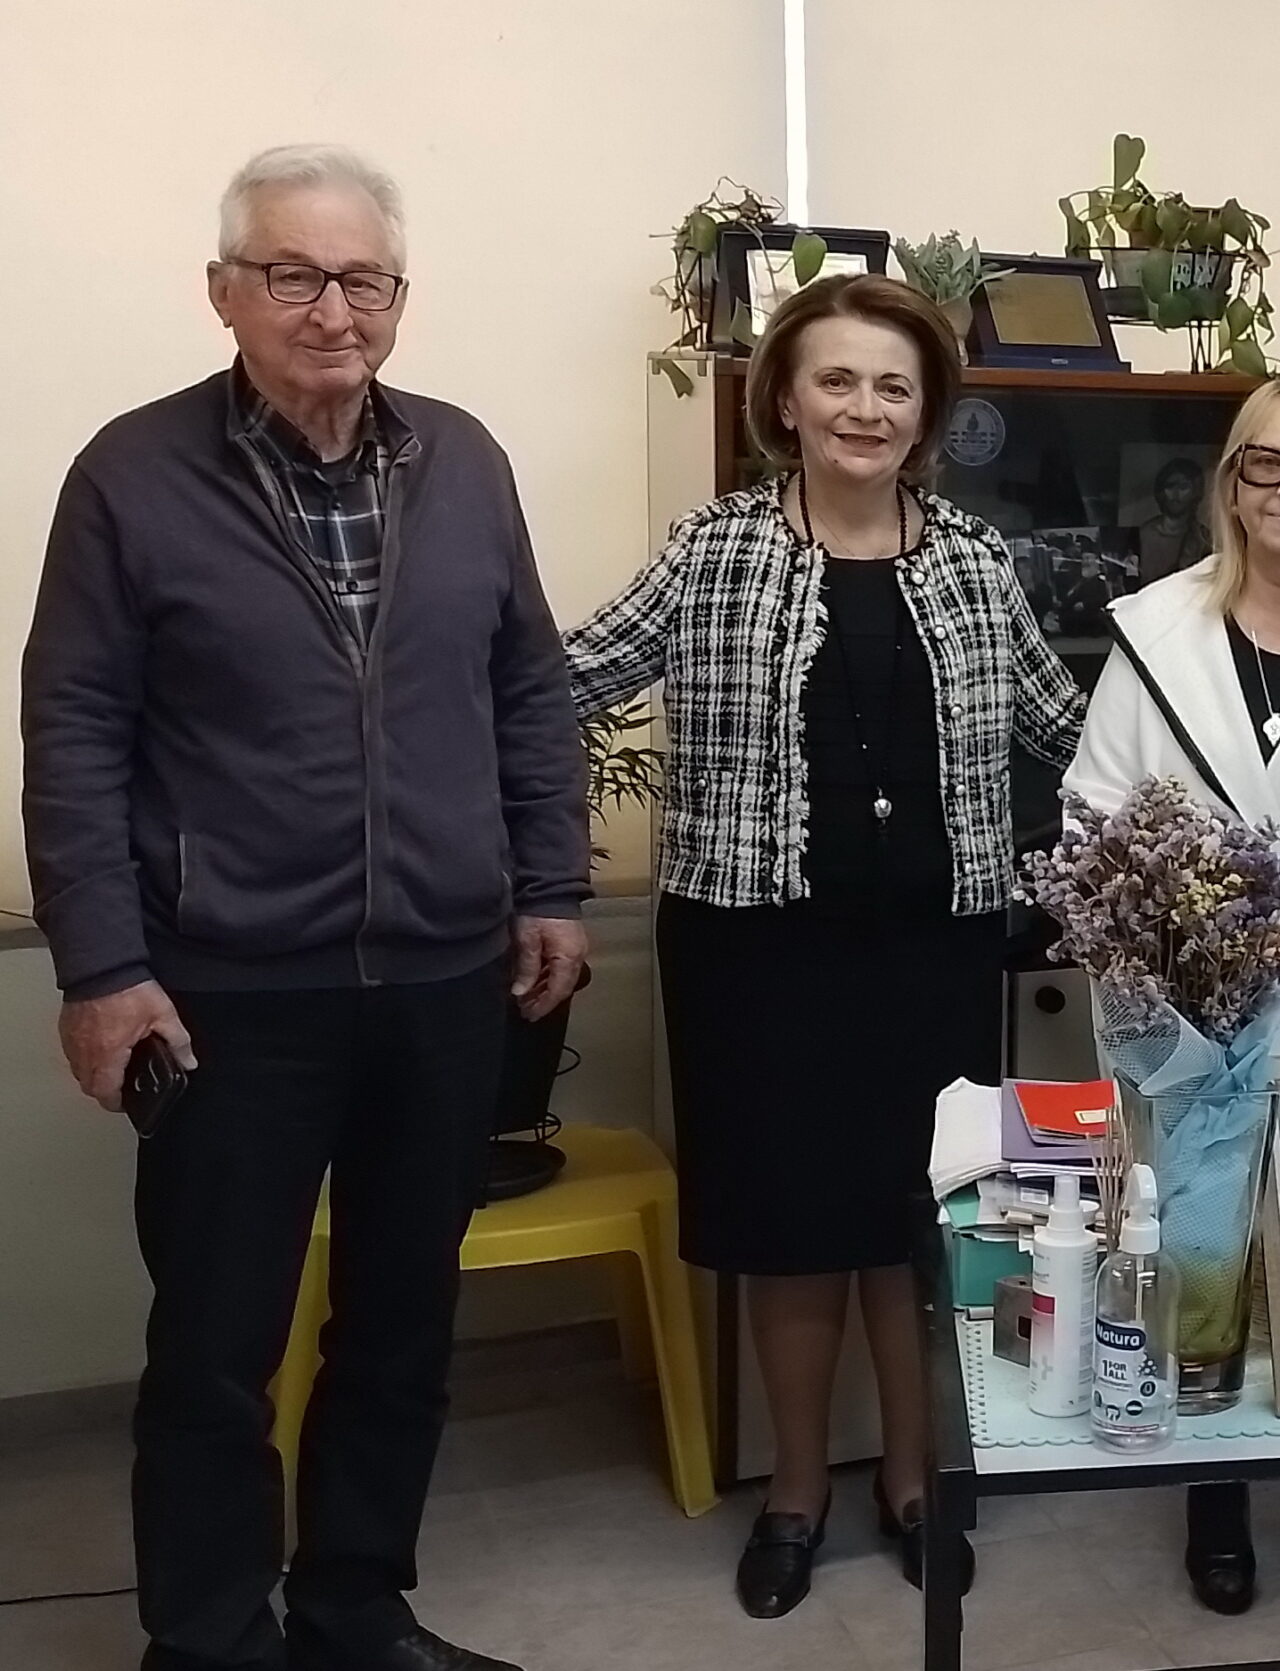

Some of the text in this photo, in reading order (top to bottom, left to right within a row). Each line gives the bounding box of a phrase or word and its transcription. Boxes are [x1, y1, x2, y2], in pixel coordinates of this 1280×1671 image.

[1096, 1323, 1140, 1346] Natura
[1102, 1359, 1108, 1377] 1
[1109, 1369, 1127, 1381] ALL
